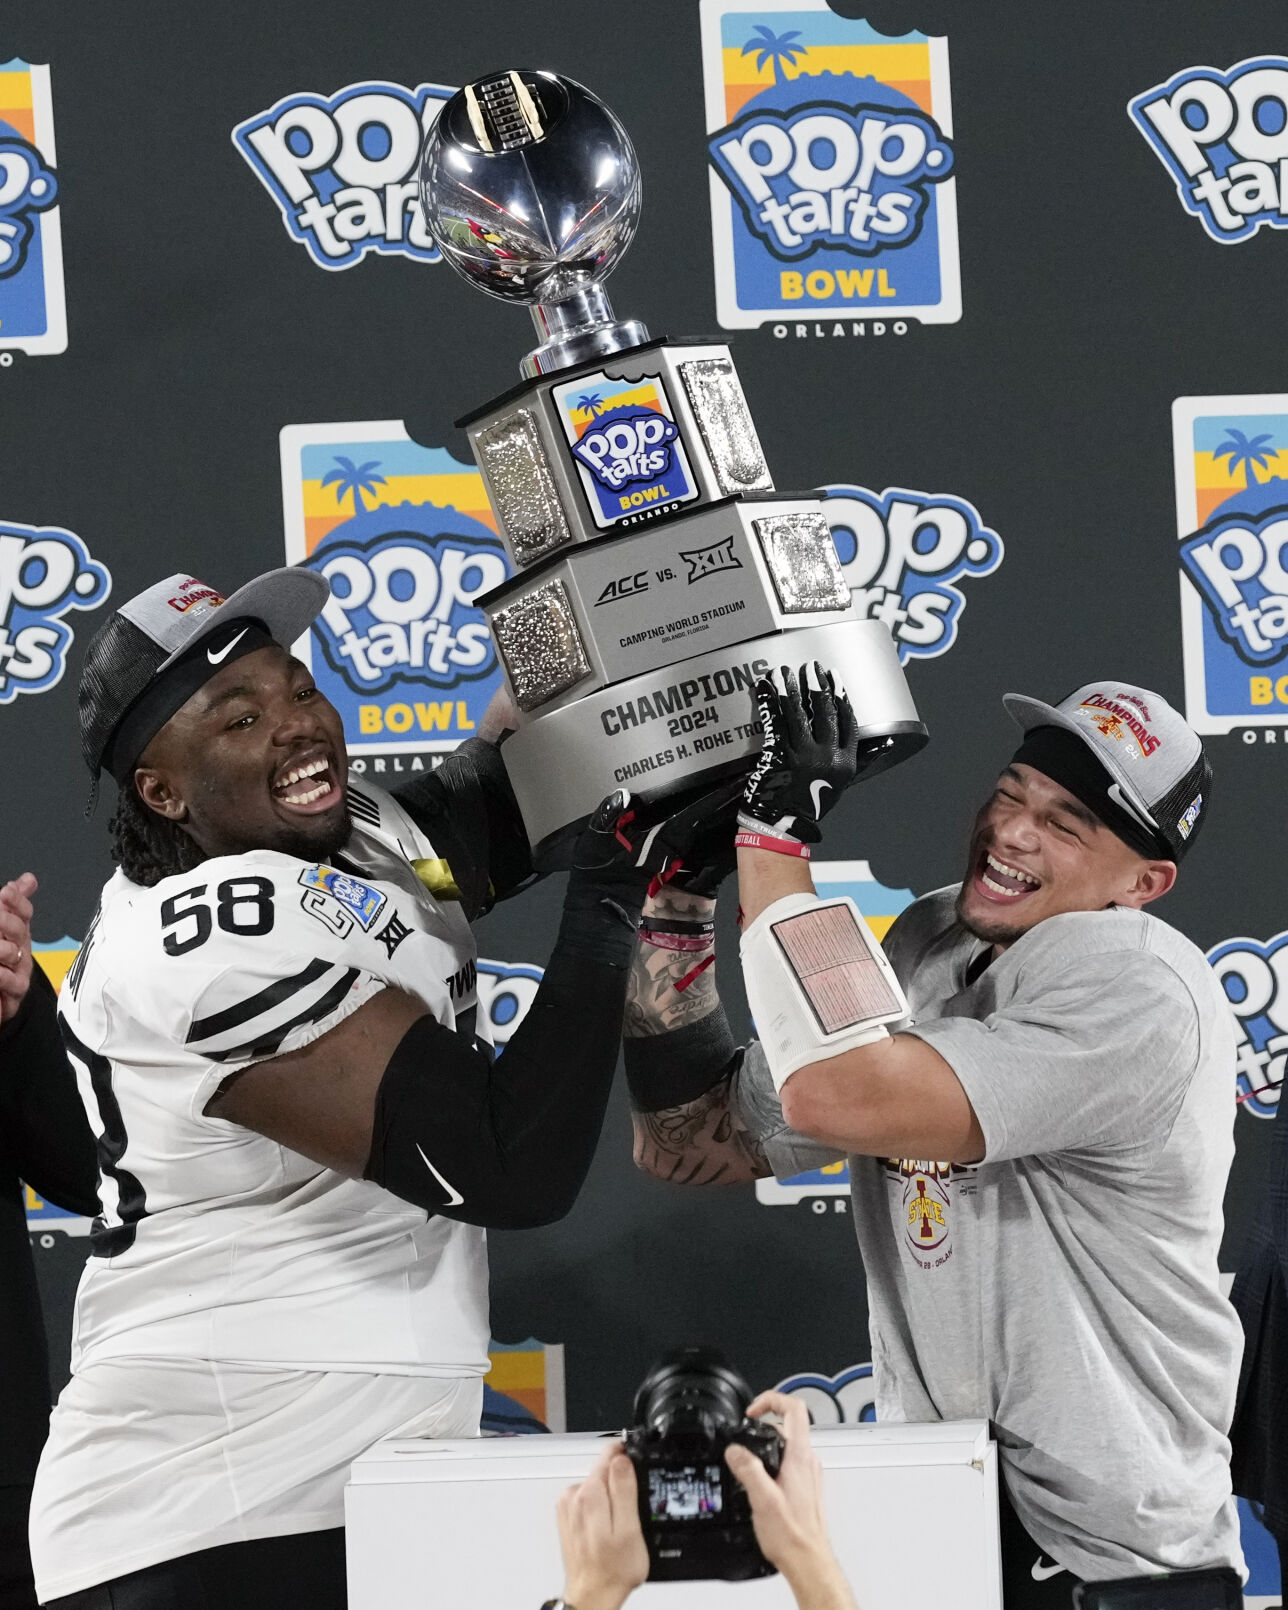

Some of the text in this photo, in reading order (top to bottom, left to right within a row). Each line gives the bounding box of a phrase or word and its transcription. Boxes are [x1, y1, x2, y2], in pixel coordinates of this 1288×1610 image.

[299, 182, 433, 257] tart
[759, 186, 913, 248] tarts
[780, 268, 896, 300] BOWL
[773, 320, 909, 340] ORLANDO
[601, 450, 665, 486] tarts
[619, 484, 670, 510] BOWL
[621, 503, 679, 526] ORLANDO
[596, 570, 649, 602] ACC
[655, 568, 677, 583] VS.
[619, 600, 746, 648] CAMPING WORLD STADIUM
[687, 624, 710, 636] FLORIDA
[338, 618, 491, 681] tarts
[600, 658, 770, 737] CHAMPIONS
[359, 701, 475, 734] BOWL
[667, 705, 719, 738] 2024
[1080, 693, 1161, 757] CHAMPIONS
[352, 756, 445, 773] ORLAN
[613, 720, 763, 783] CHARLES H. ROHE TRO
[160, 875, 276, 957] 58
[300, 889, 355, 940] C
[908, 1196, 946, 1227] STATE
